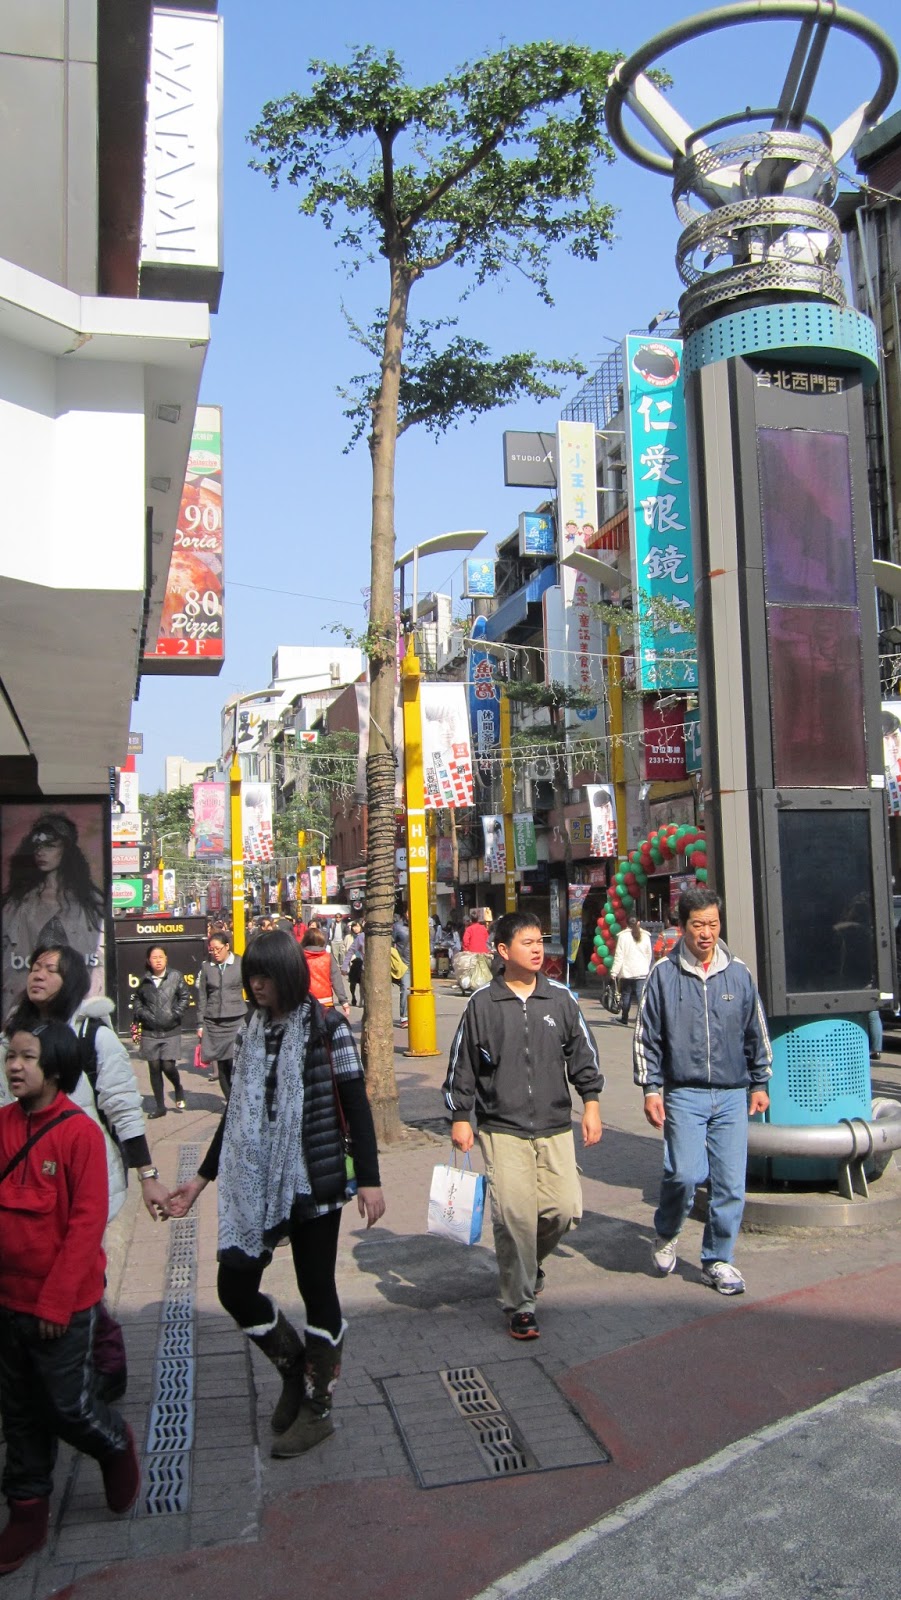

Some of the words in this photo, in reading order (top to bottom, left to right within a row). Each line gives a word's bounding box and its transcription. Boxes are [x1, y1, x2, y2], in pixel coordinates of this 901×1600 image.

[755, 368, 844, 395] 台北西門町
[511, 454, 541, 462] STUDIO
[569, 451, 588, 520] 小王子
[184, 504, 219, 532] 90
[185, 589, 219, 616] 80
[170, 613, 220, 639] Pizza
[648, 757, 684, 765] 2331-9273
[411, 824, 422, 838] H
[409, 847, 425, 858] 26
[136, 923, 185, 934] bauhaus
